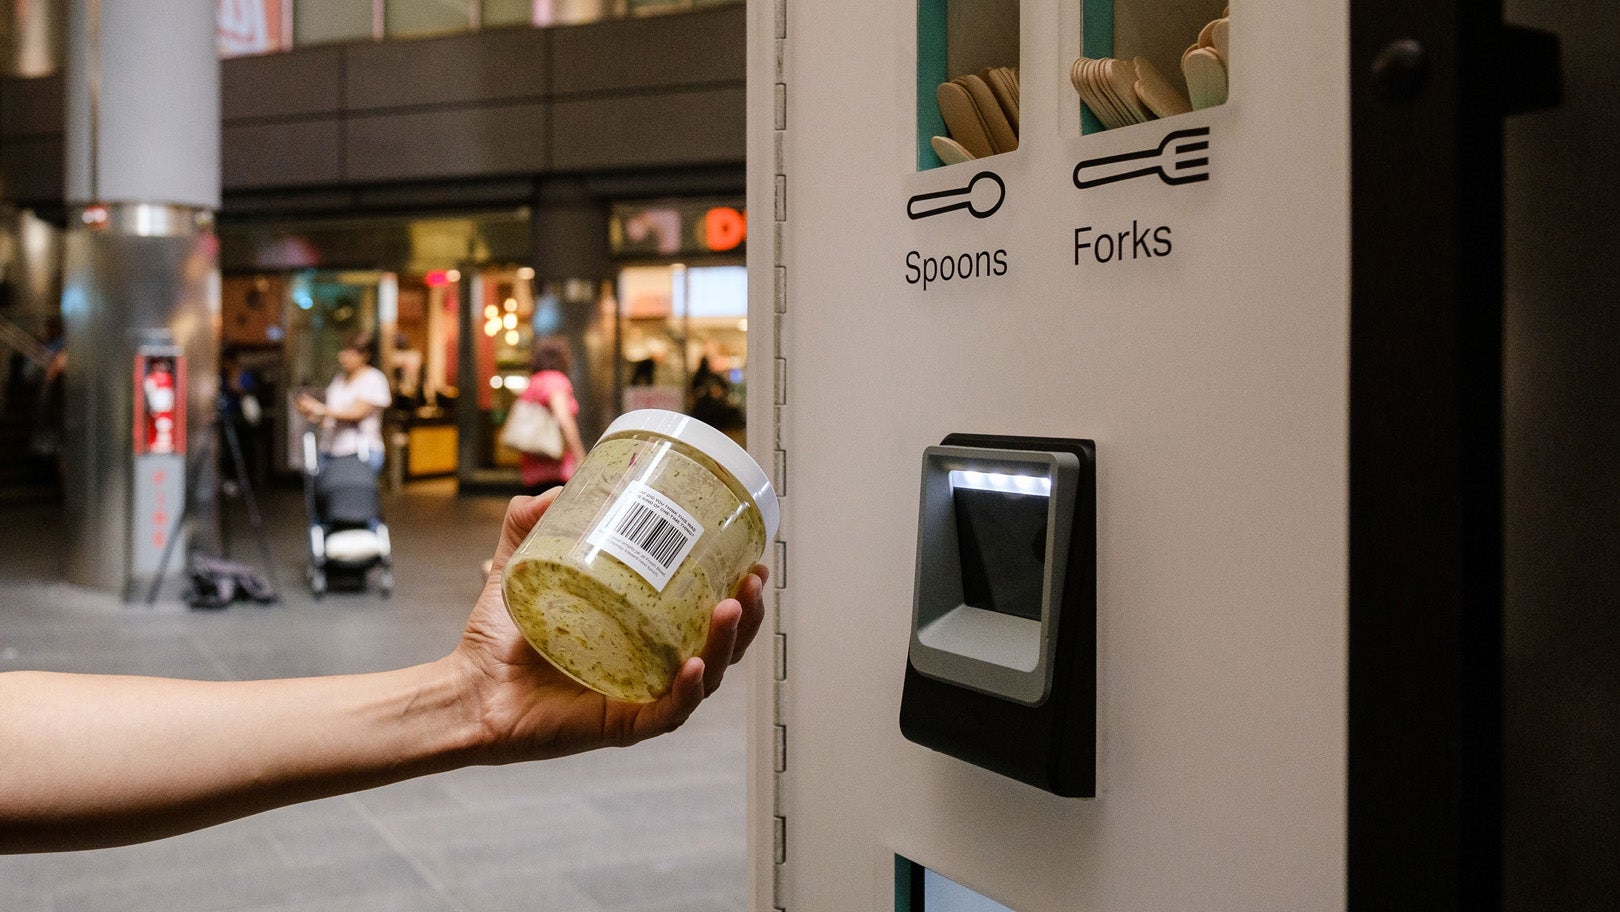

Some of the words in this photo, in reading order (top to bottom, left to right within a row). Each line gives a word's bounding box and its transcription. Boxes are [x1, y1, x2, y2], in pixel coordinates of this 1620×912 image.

[1074, 220, 1173, 265] Forks
[905, 249, 1008, 290] Spoons
[646, 492, 656, 501] DID
[655, 498, 665, 507] YOU
[664, 504, 678, 516] THINK
[677, 513, 688, 525] THIS
[687, 522, 697, 533] WAS
[659, 507, 681, 525] ONE-TIME
